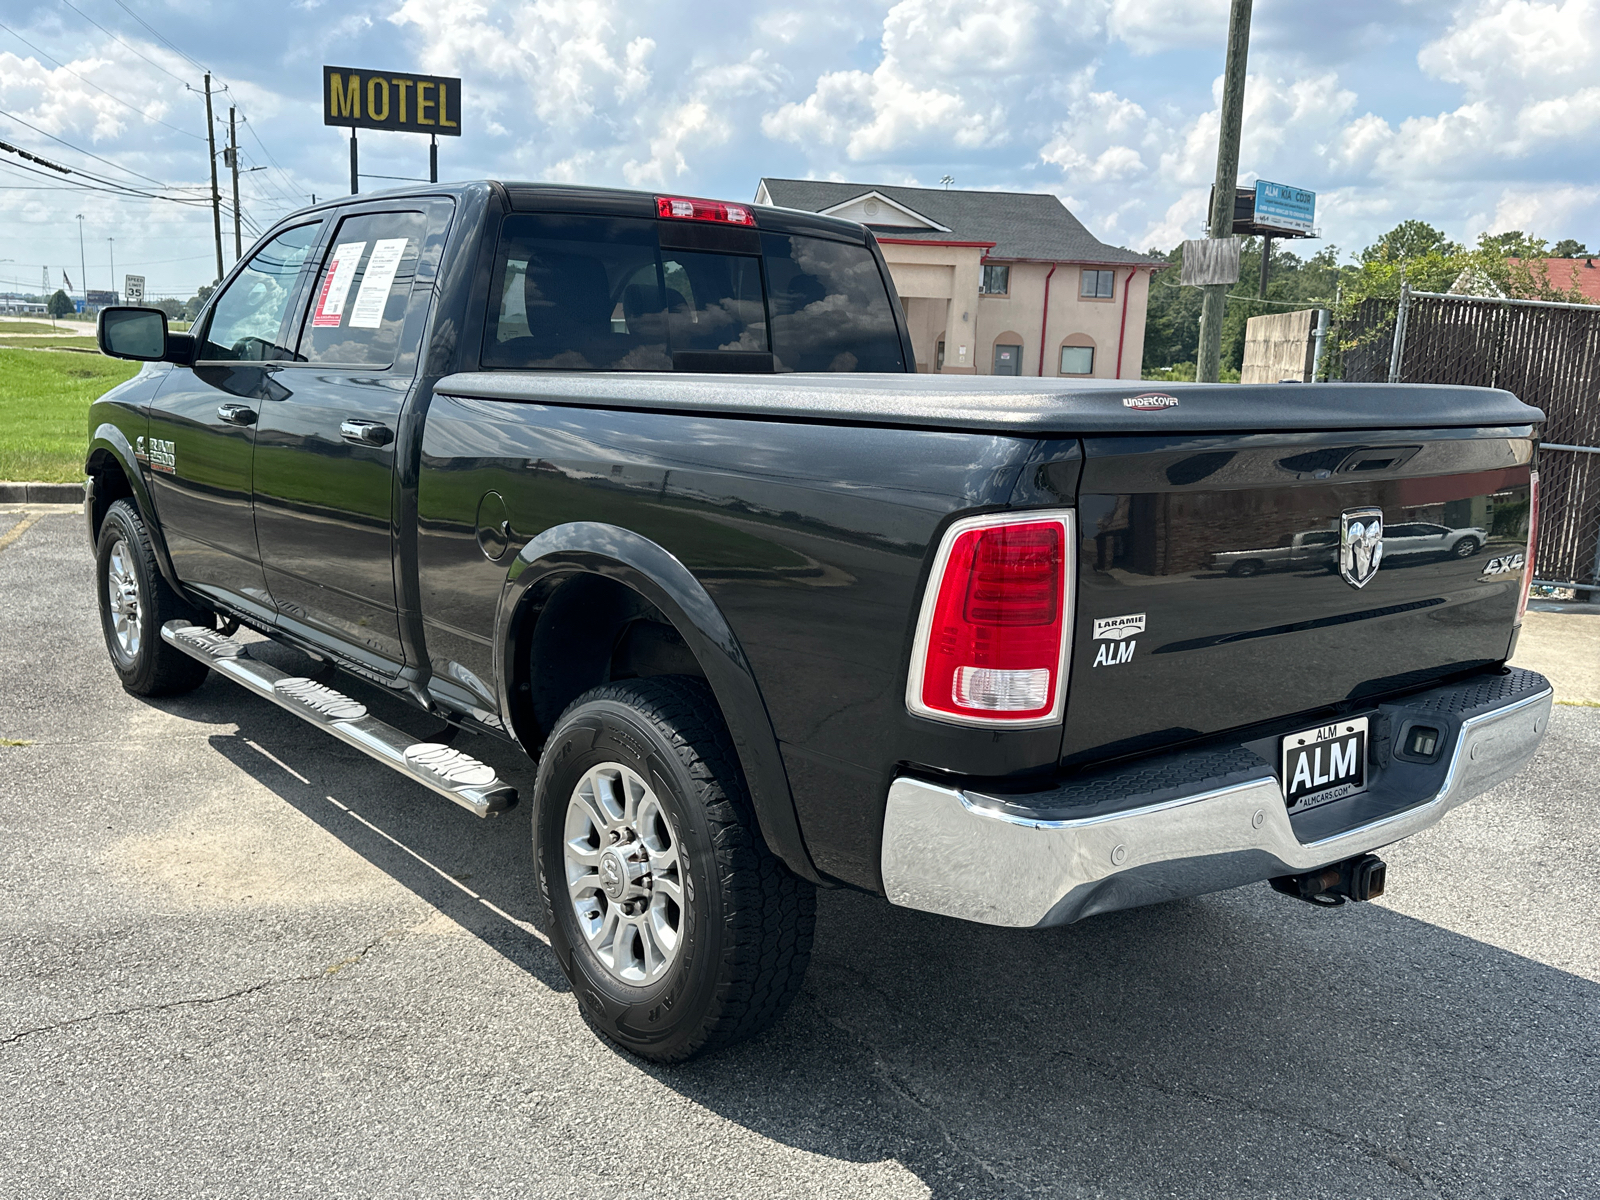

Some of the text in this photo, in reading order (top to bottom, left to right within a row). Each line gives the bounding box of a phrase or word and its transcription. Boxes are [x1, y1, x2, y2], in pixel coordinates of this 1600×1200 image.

[330, 73, 457, 127] MOTEL
[1265, 186, 1311, 204] ALM KIA CDJR
[128, 288, 142, 296] 35
[149, 437, 175, 454] RAM
[1098, 615, 1144, 629] LARAMIE
[1092, 640, 1137, 668] ALM
[1316, 725, 1337, 741] ALM
[1289, 737, 1357, 794] ALM
[647, 811, 697, 1023] GOODYEAR
